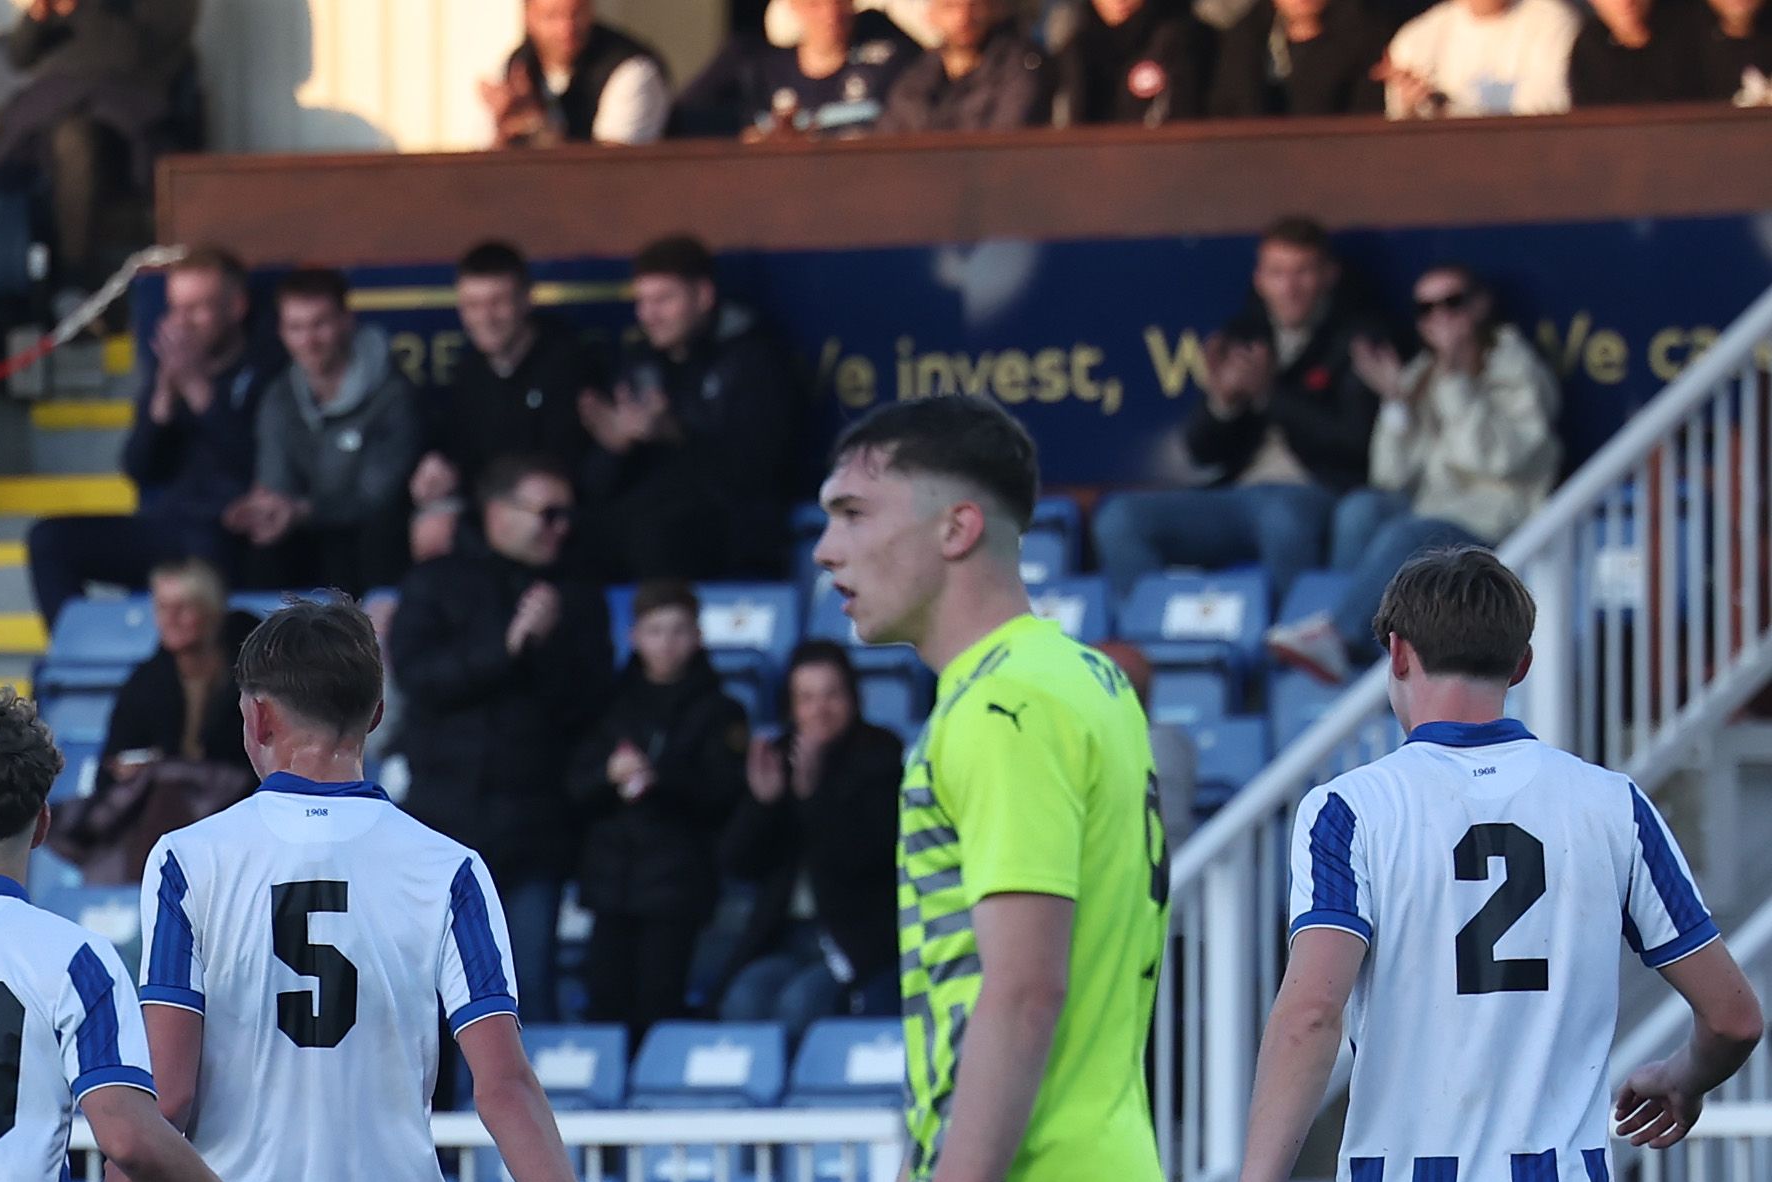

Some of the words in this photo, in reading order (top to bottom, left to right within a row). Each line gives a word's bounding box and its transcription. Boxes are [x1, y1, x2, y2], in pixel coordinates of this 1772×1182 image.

[895, 333, 1121, 416] invest,
[306, 808, 329, 817] 1908
[1472, 766, 1496, 777] 1908
[1453, 822, 1549, 995] 2
[270, 880, 358, 1048] 5
